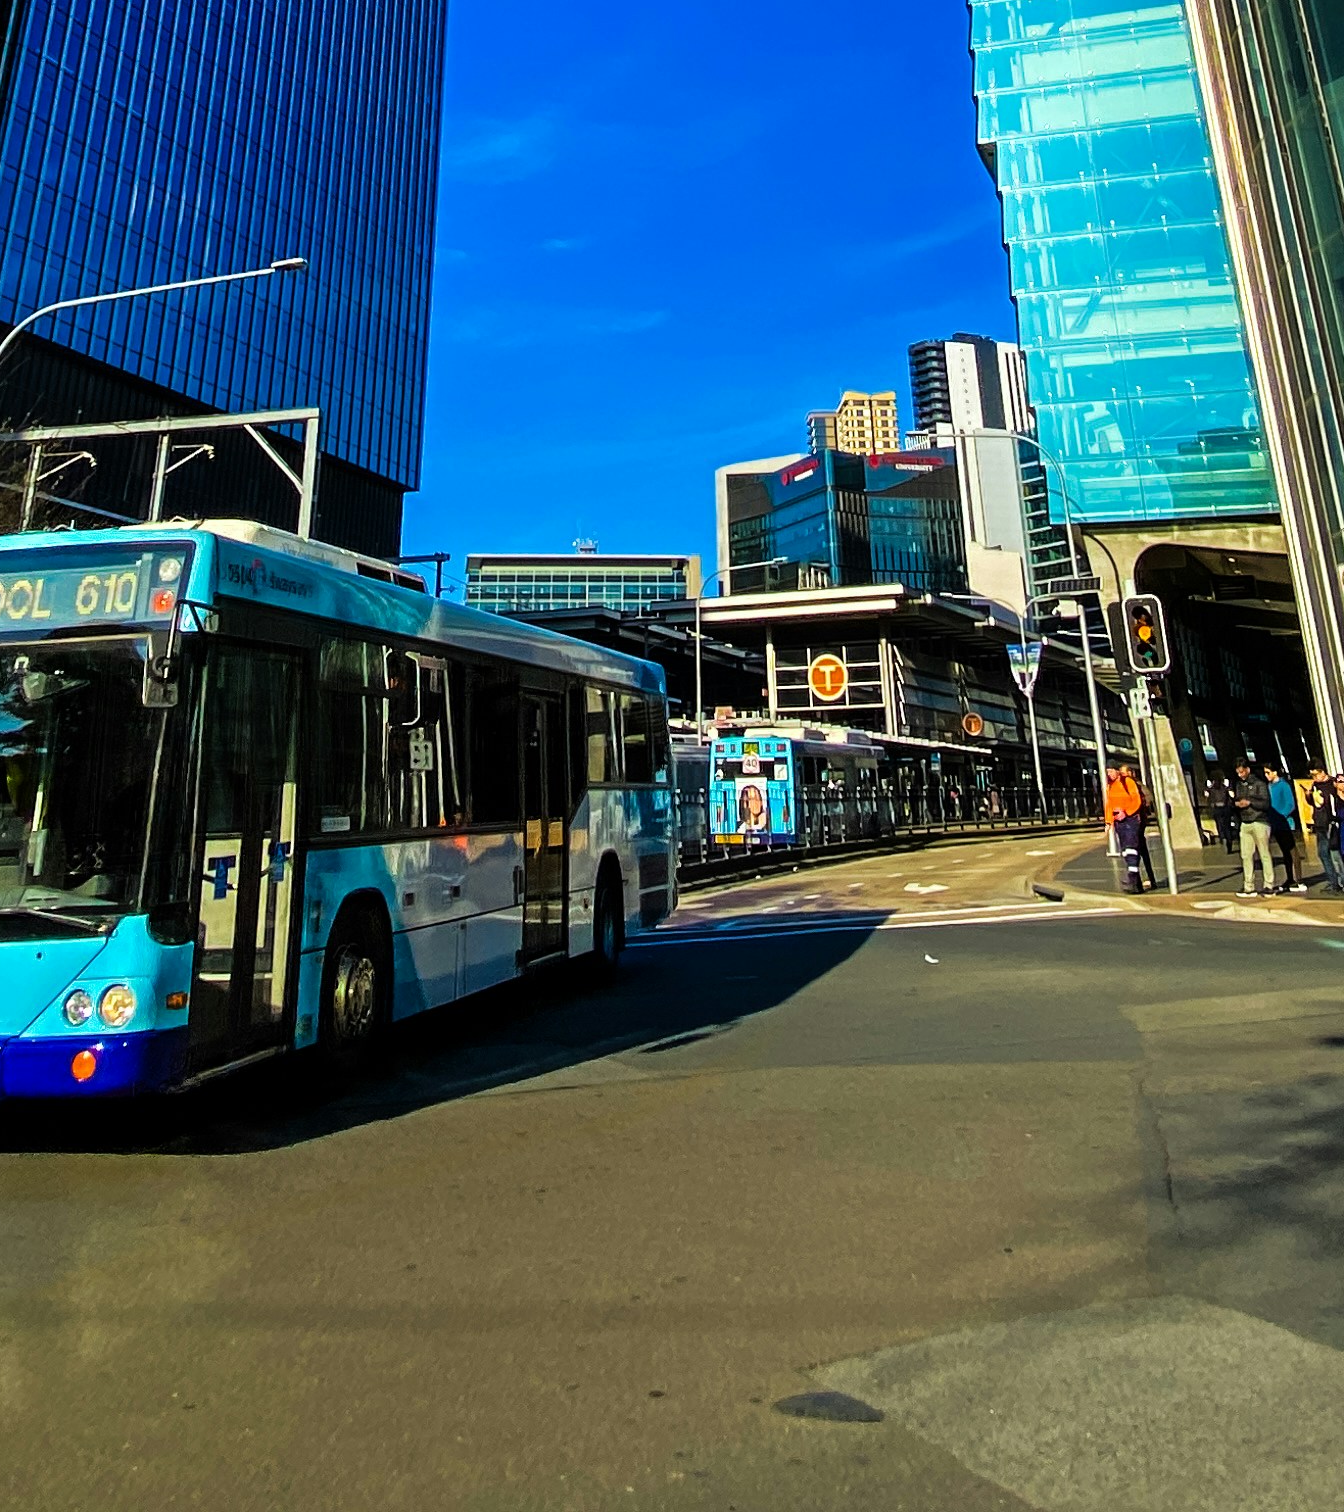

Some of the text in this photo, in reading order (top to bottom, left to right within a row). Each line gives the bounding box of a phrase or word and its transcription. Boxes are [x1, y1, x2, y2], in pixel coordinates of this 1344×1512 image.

[74, 572, 137, 615] 610
[817, 665, 836, 692] T
[745, 758, 757, 768] 40
